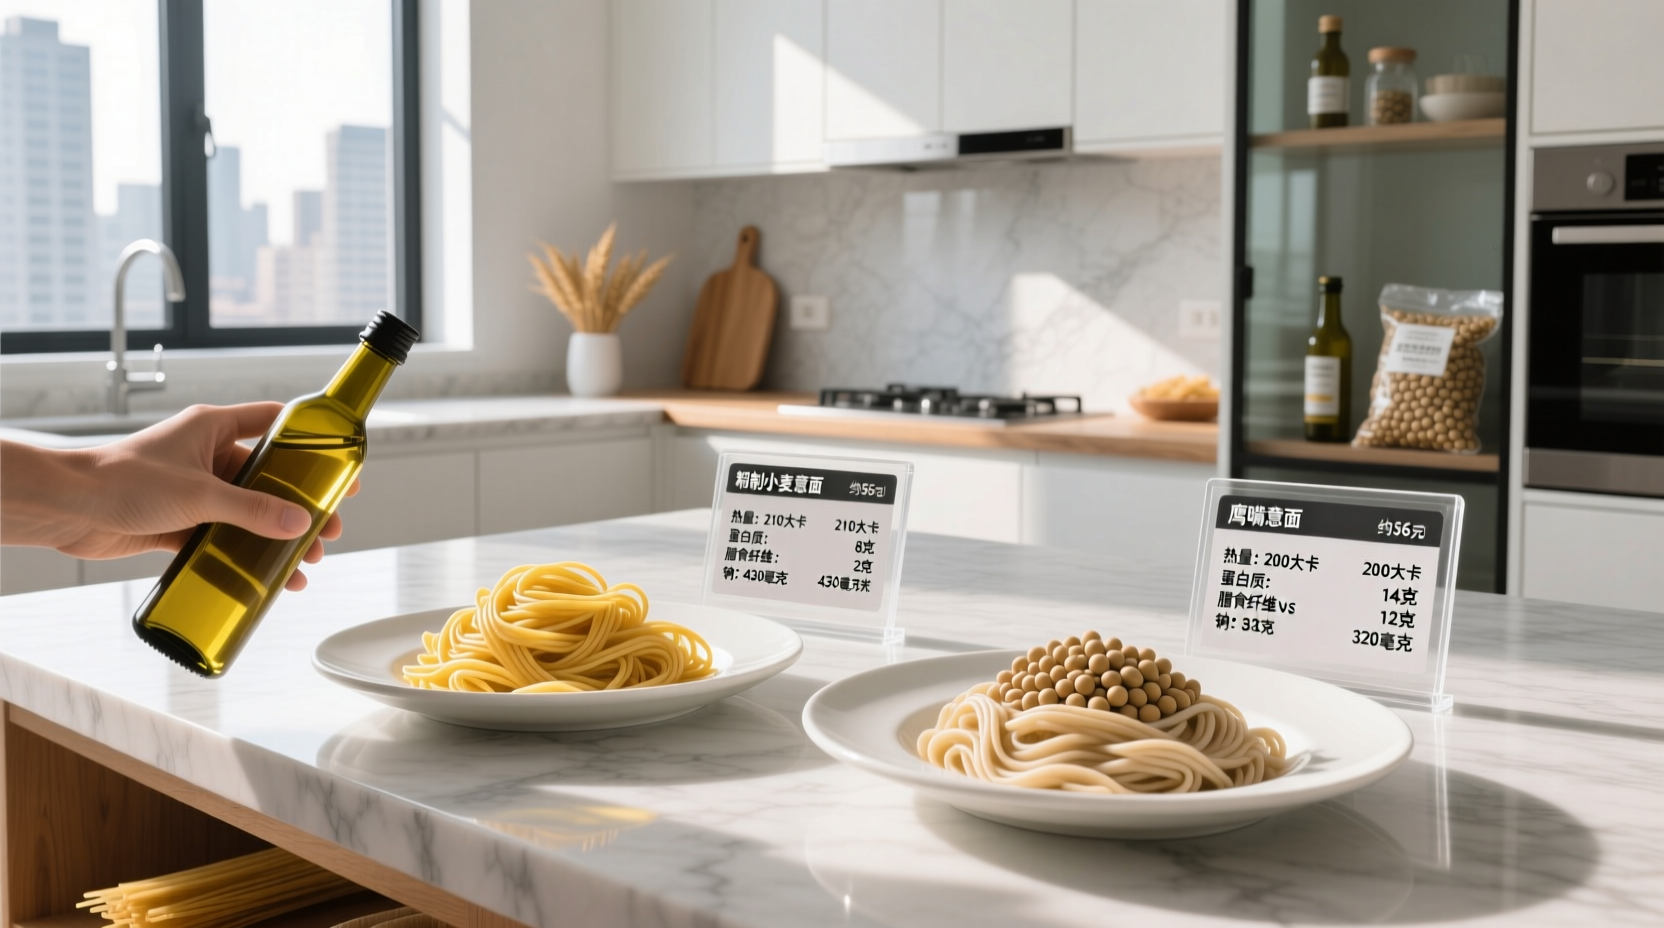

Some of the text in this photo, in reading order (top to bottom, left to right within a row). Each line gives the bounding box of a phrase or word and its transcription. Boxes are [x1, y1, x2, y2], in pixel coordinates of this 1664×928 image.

[834, 519, 879, 534] 210大卡
[855, 539, 875, 554] 8克
[1362, 561, 1422, 580] 200大卡
[1382, 587, 1419, 606] 14克
[1380, 610, 1416, 629] 12克
[1352, 629, 1413, 652] 320毫克
